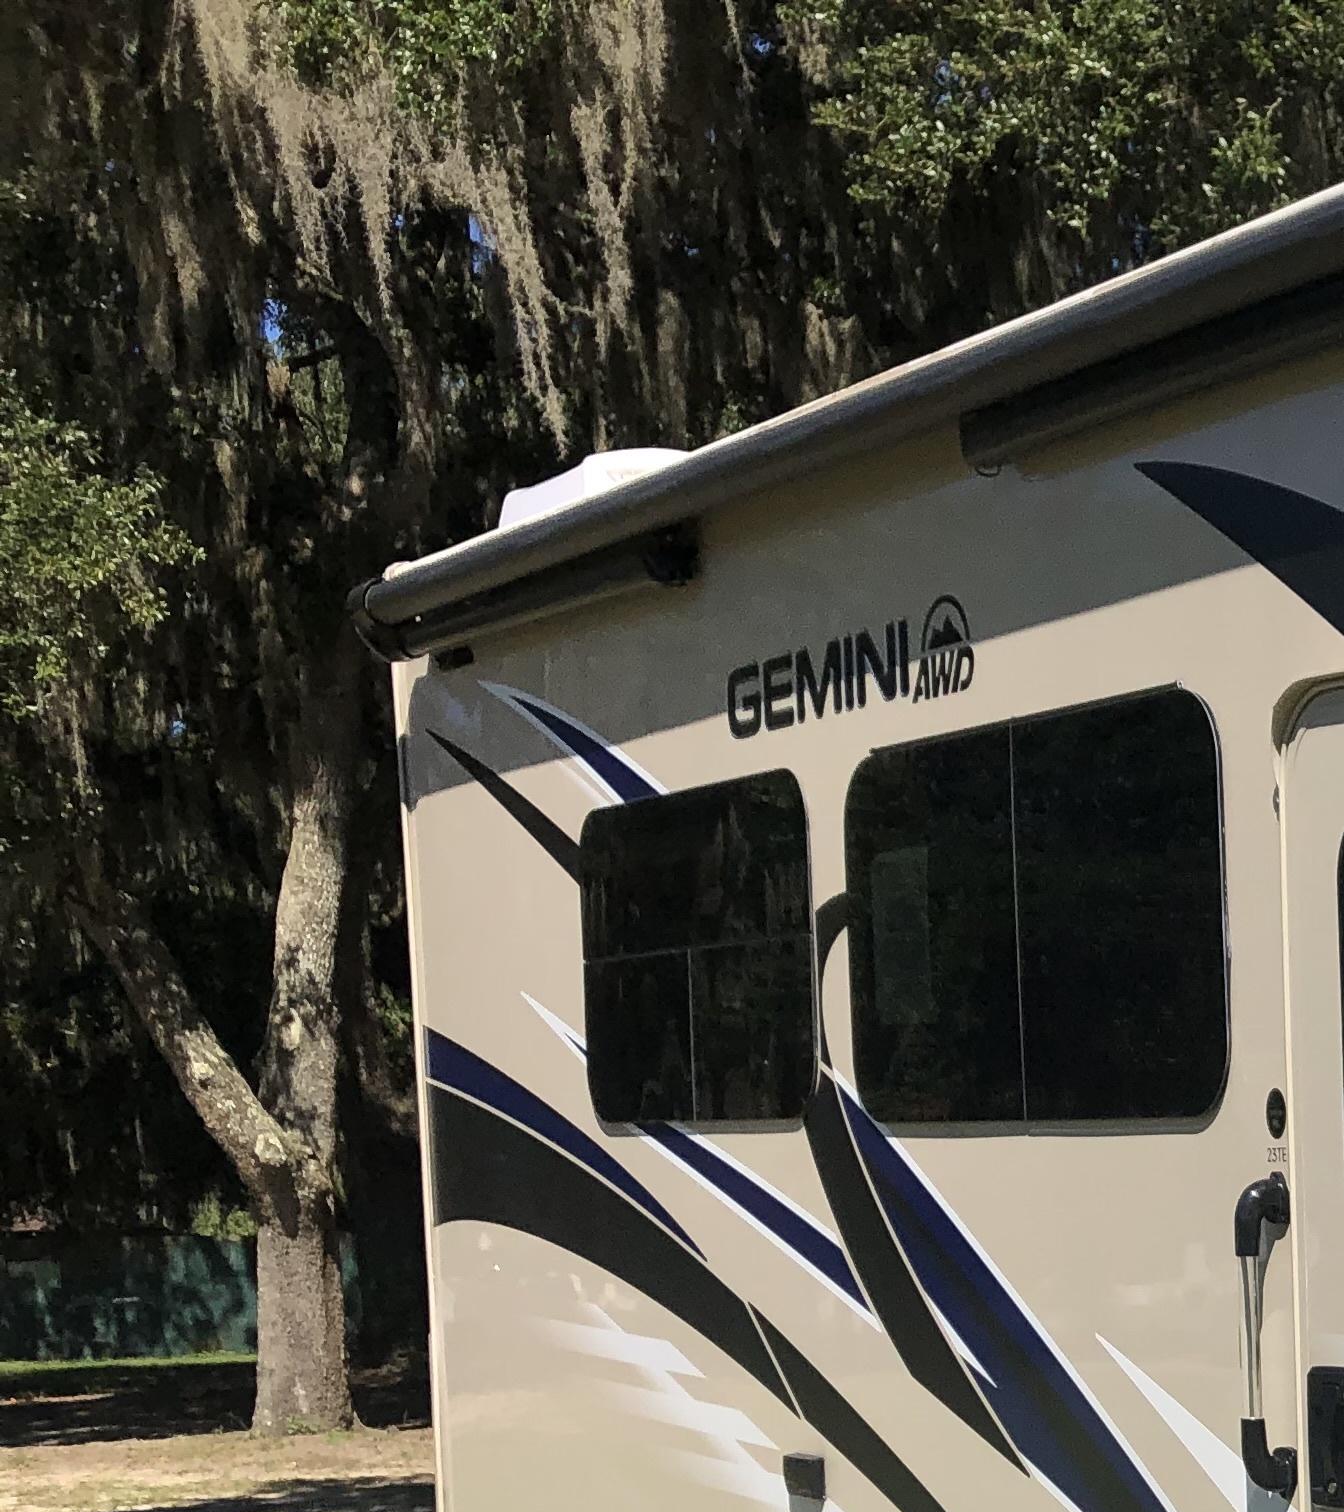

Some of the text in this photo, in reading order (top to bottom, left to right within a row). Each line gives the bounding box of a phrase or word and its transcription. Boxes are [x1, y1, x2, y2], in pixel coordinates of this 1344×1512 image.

[727, 617, 910, 740] GEMINI
[912, 644, 975, 704] AWD
[1267, 1147, 1287, 1163] 23TE
